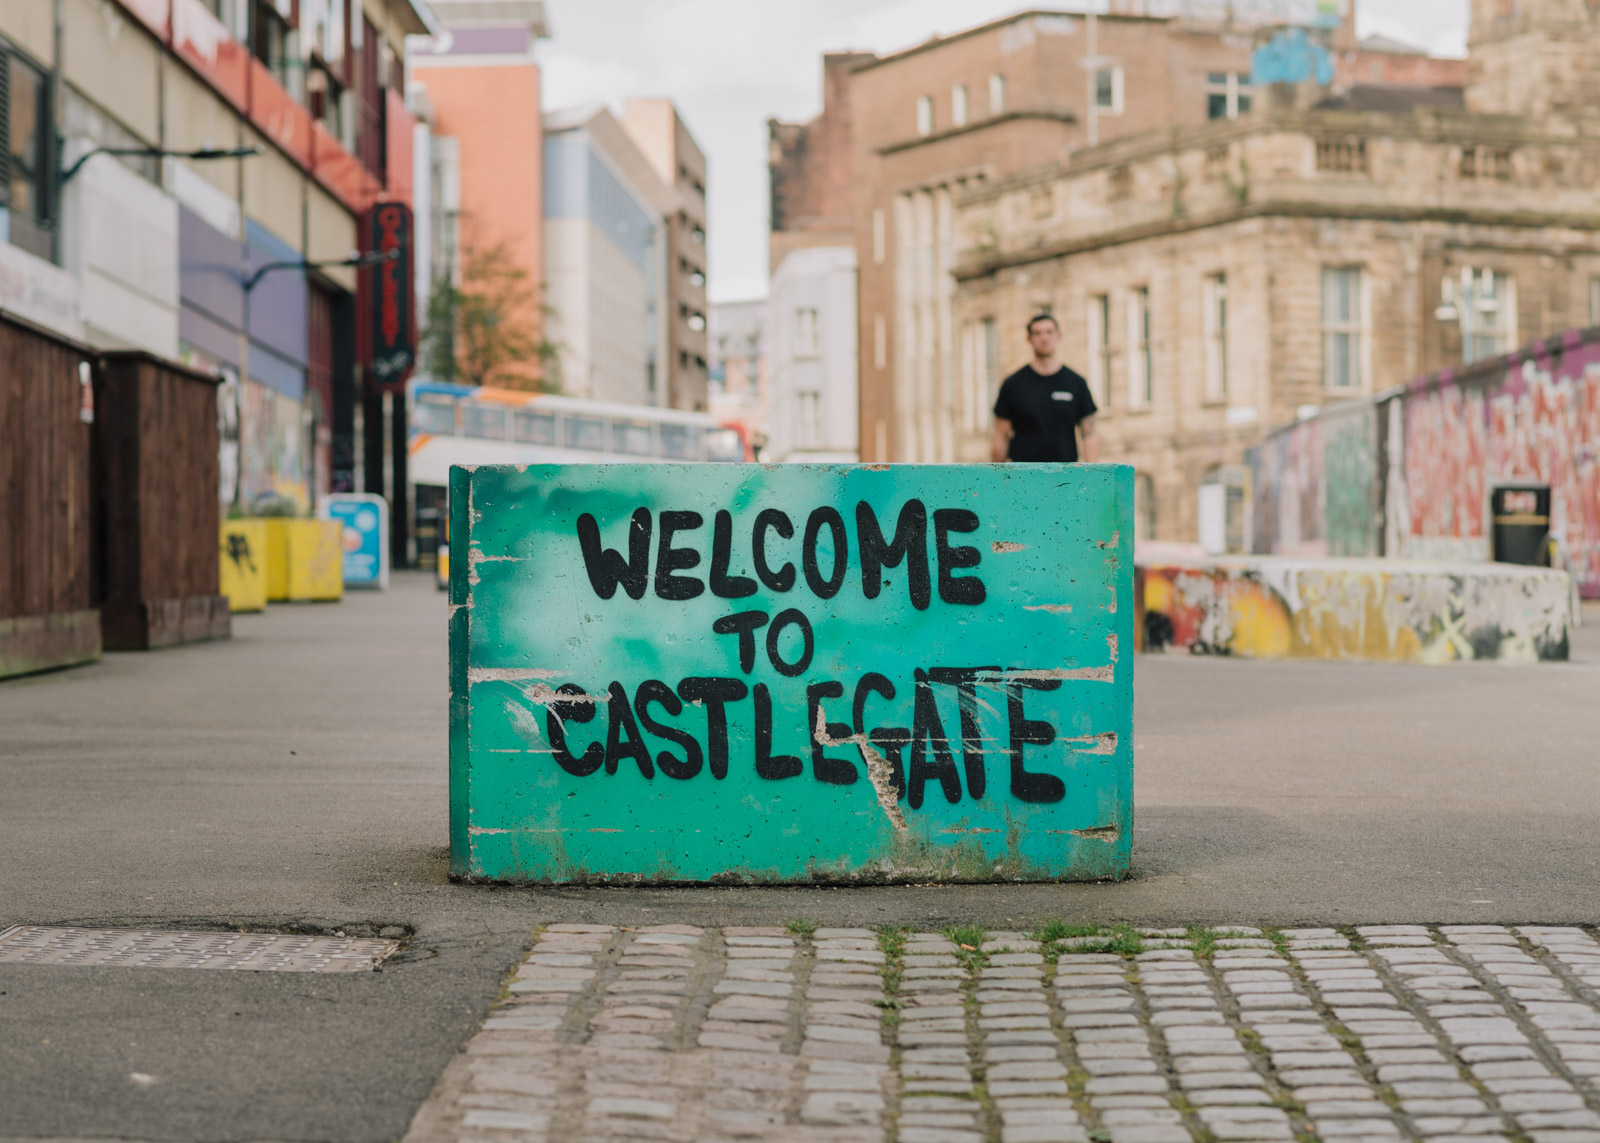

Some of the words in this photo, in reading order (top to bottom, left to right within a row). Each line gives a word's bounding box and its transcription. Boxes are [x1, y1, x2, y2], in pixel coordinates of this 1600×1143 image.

[577, 499, 986, 610] WELCOME
[713, 609, 814, 676] TO
[547, 667, 1065, 809] CASTLEGATE
